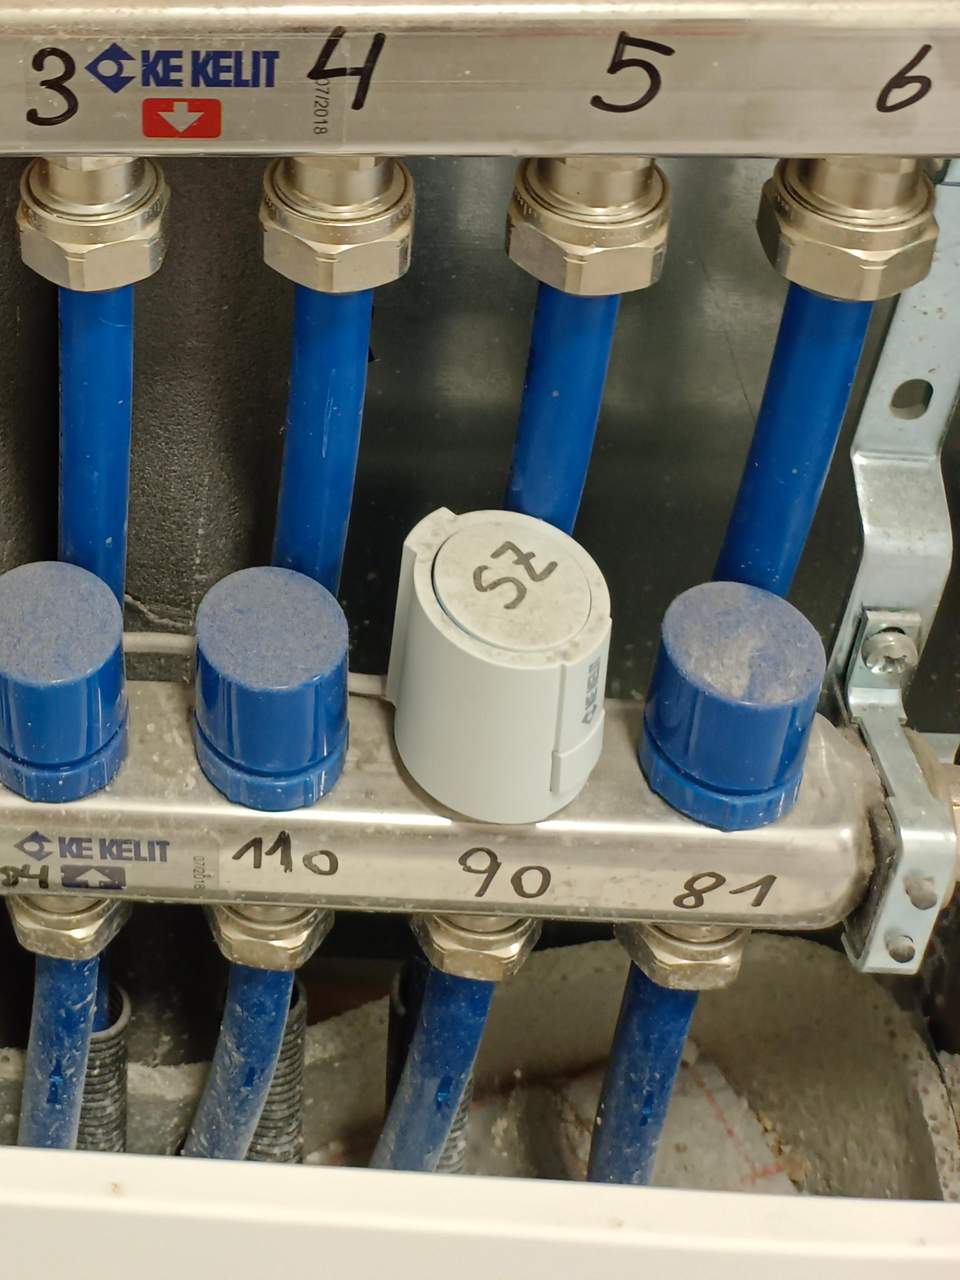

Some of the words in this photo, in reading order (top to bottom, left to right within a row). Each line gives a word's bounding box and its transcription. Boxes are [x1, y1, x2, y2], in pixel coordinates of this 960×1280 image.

[26, 47, 80, 126] 3
[141, 50, 183, 87] KE
[191, 50, 280, 88] KELIT
[306, 26, 386, 110] 4
[590, 30, 675, 113] 5
[875, 43, 932, 113] 6
[313, 77, 331, 136] 07/2018
[473, 540, 558, 610] SZ
[58, 836, 93, 859] KE
[98, 838, 170, 862] KELIT
[232, 830, 339, 875] 110
[458, 846, 551, 899] 90
[673, 871, 777, 910] 81
